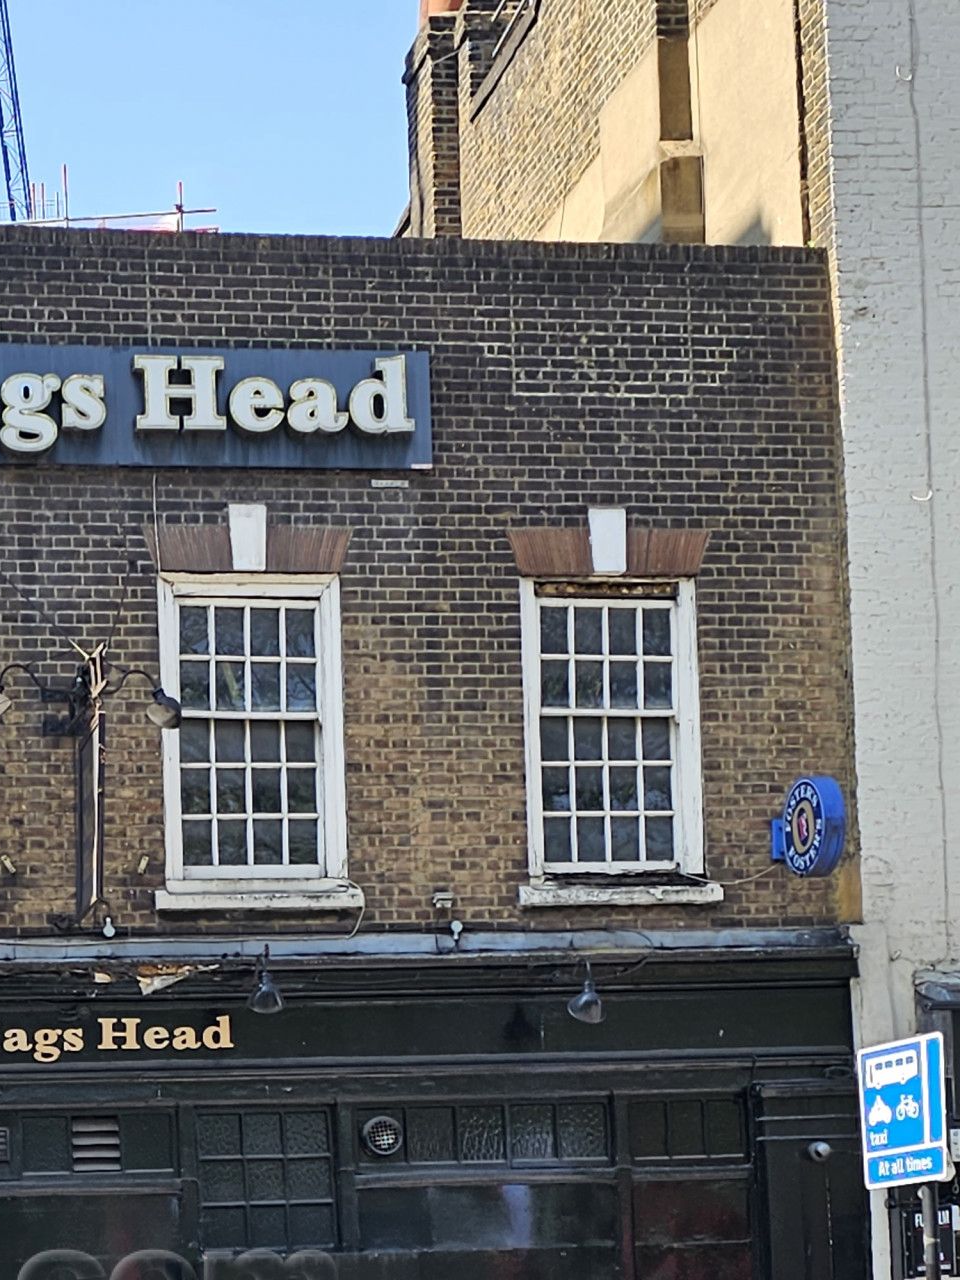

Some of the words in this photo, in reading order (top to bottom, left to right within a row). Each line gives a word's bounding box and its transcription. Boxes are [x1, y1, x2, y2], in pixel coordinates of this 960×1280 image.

[133, 354, 416, 433] Head
[96, 1015, 235, 1051] Head
[869, 1128, 888, 1146] taxi
[878, 1160, 890, 1177] At
[890, 1157, 905, 1175] all
[906, 1156, 933, 1173] times
